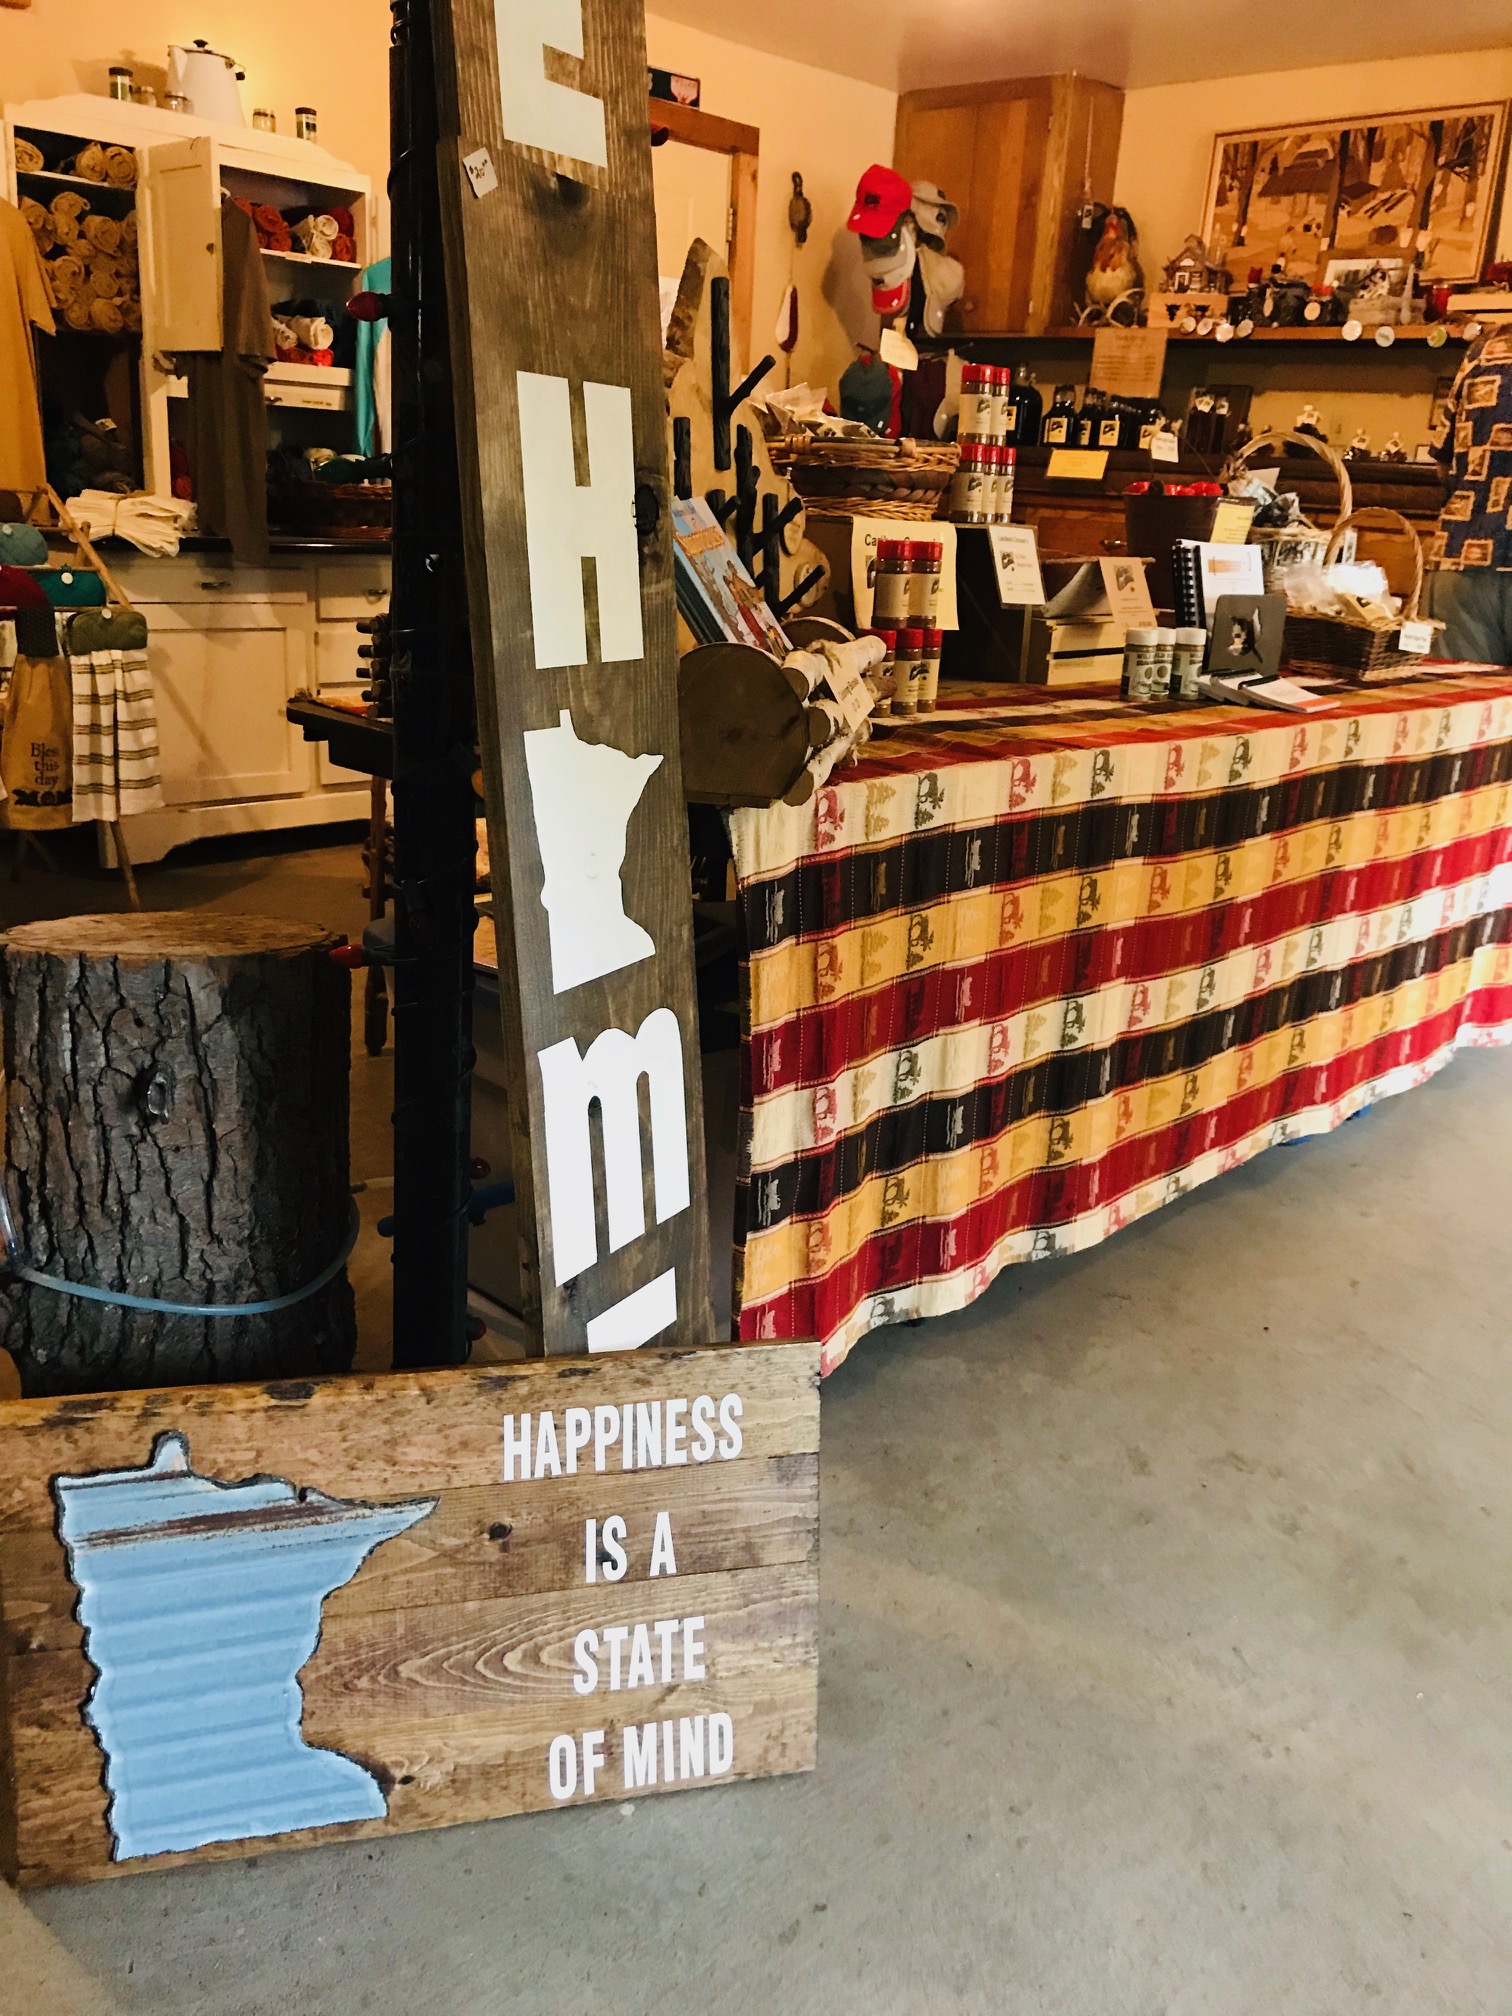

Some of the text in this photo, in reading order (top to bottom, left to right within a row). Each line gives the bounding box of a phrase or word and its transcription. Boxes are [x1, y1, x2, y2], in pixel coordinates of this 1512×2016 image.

[35, 771, 59, 789] day
[502, 1393, 744, 1481] HAPPINESS
[585, 1511, 677, 1584] IS A
[573, 1615, 706, 1696] STATE
[548, 1711, 735, 1801] OF MIND
